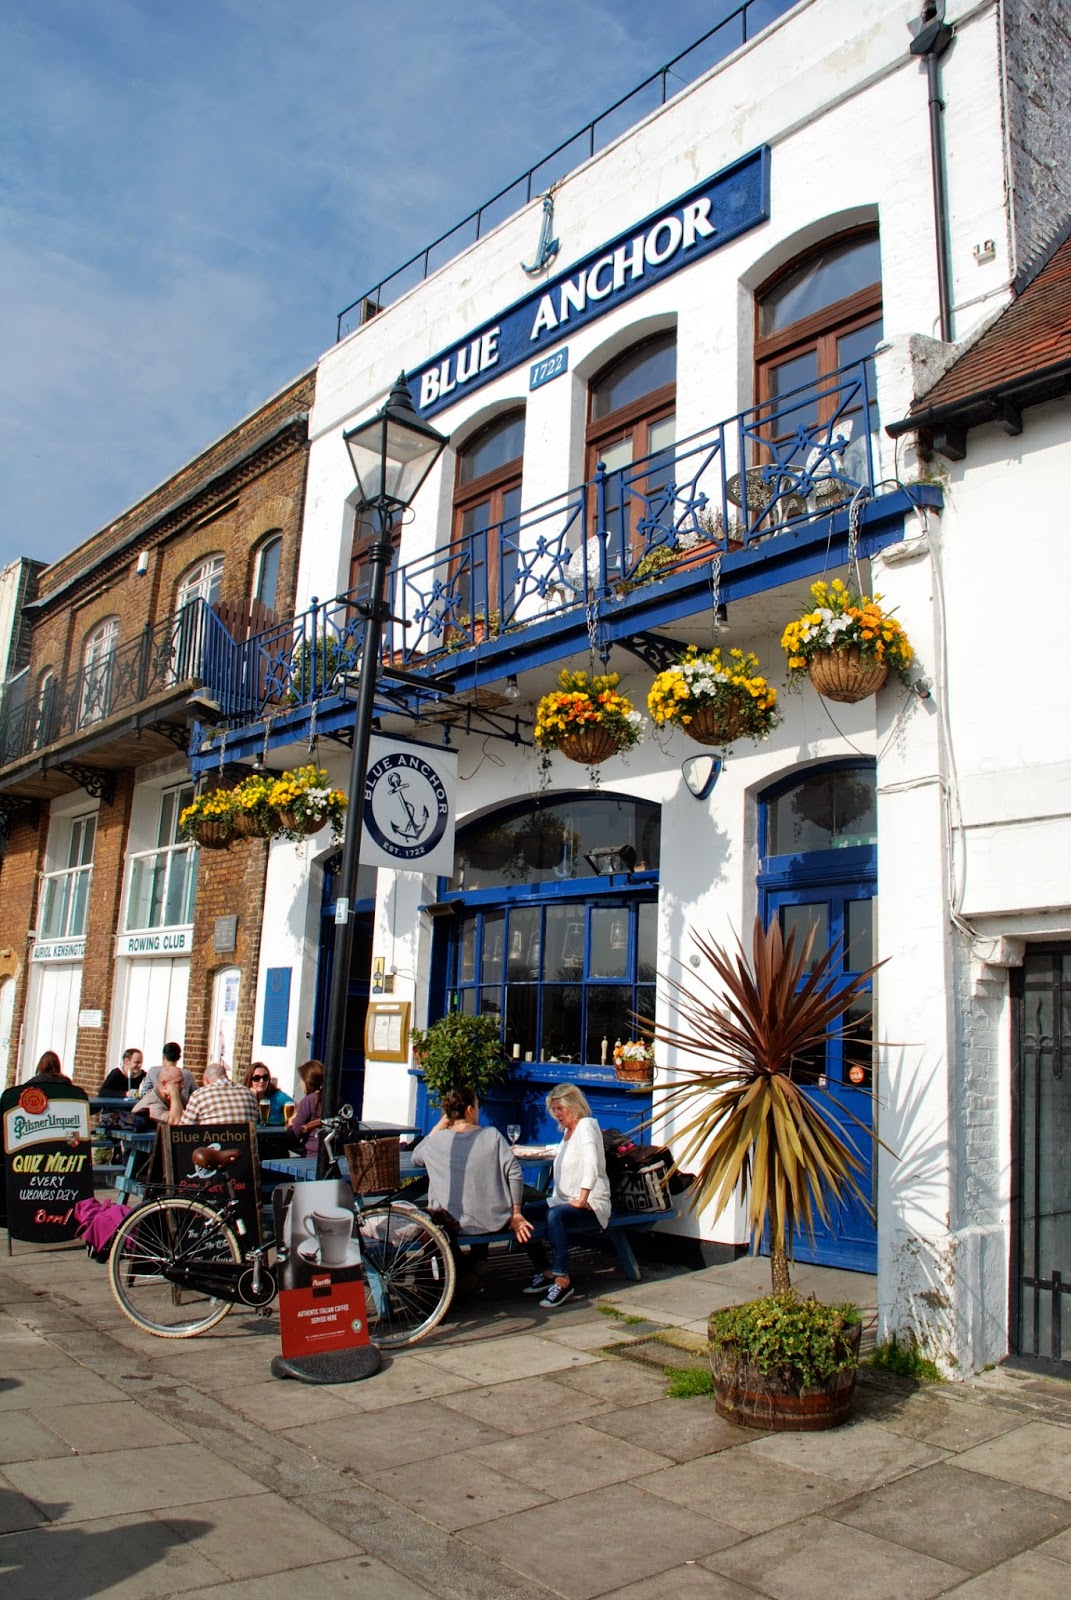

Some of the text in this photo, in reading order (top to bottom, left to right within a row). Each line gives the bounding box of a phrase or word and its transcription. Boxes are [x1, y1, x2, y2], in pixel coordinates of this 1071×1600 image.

[419, 197, 717, 410] BLUE ANCHOR
[531, 353, 564, 386] 1722
[364, 755, 448, 814] BLUE ANCHOR
[383, 841, 426, 857] EST. 1722
[128, 934, 186, 952] ROWING CLUB
[14, 1113, 80, 1139] Pilsner Urquell
[172, 1130, 248, 1143] Blue Anchor
[12, 1152, 87, 1173] QUIZ NIGHT
[30, 1175, 66, 1188] EVERY
[334, 1304, 349, 1312] COFFEE
